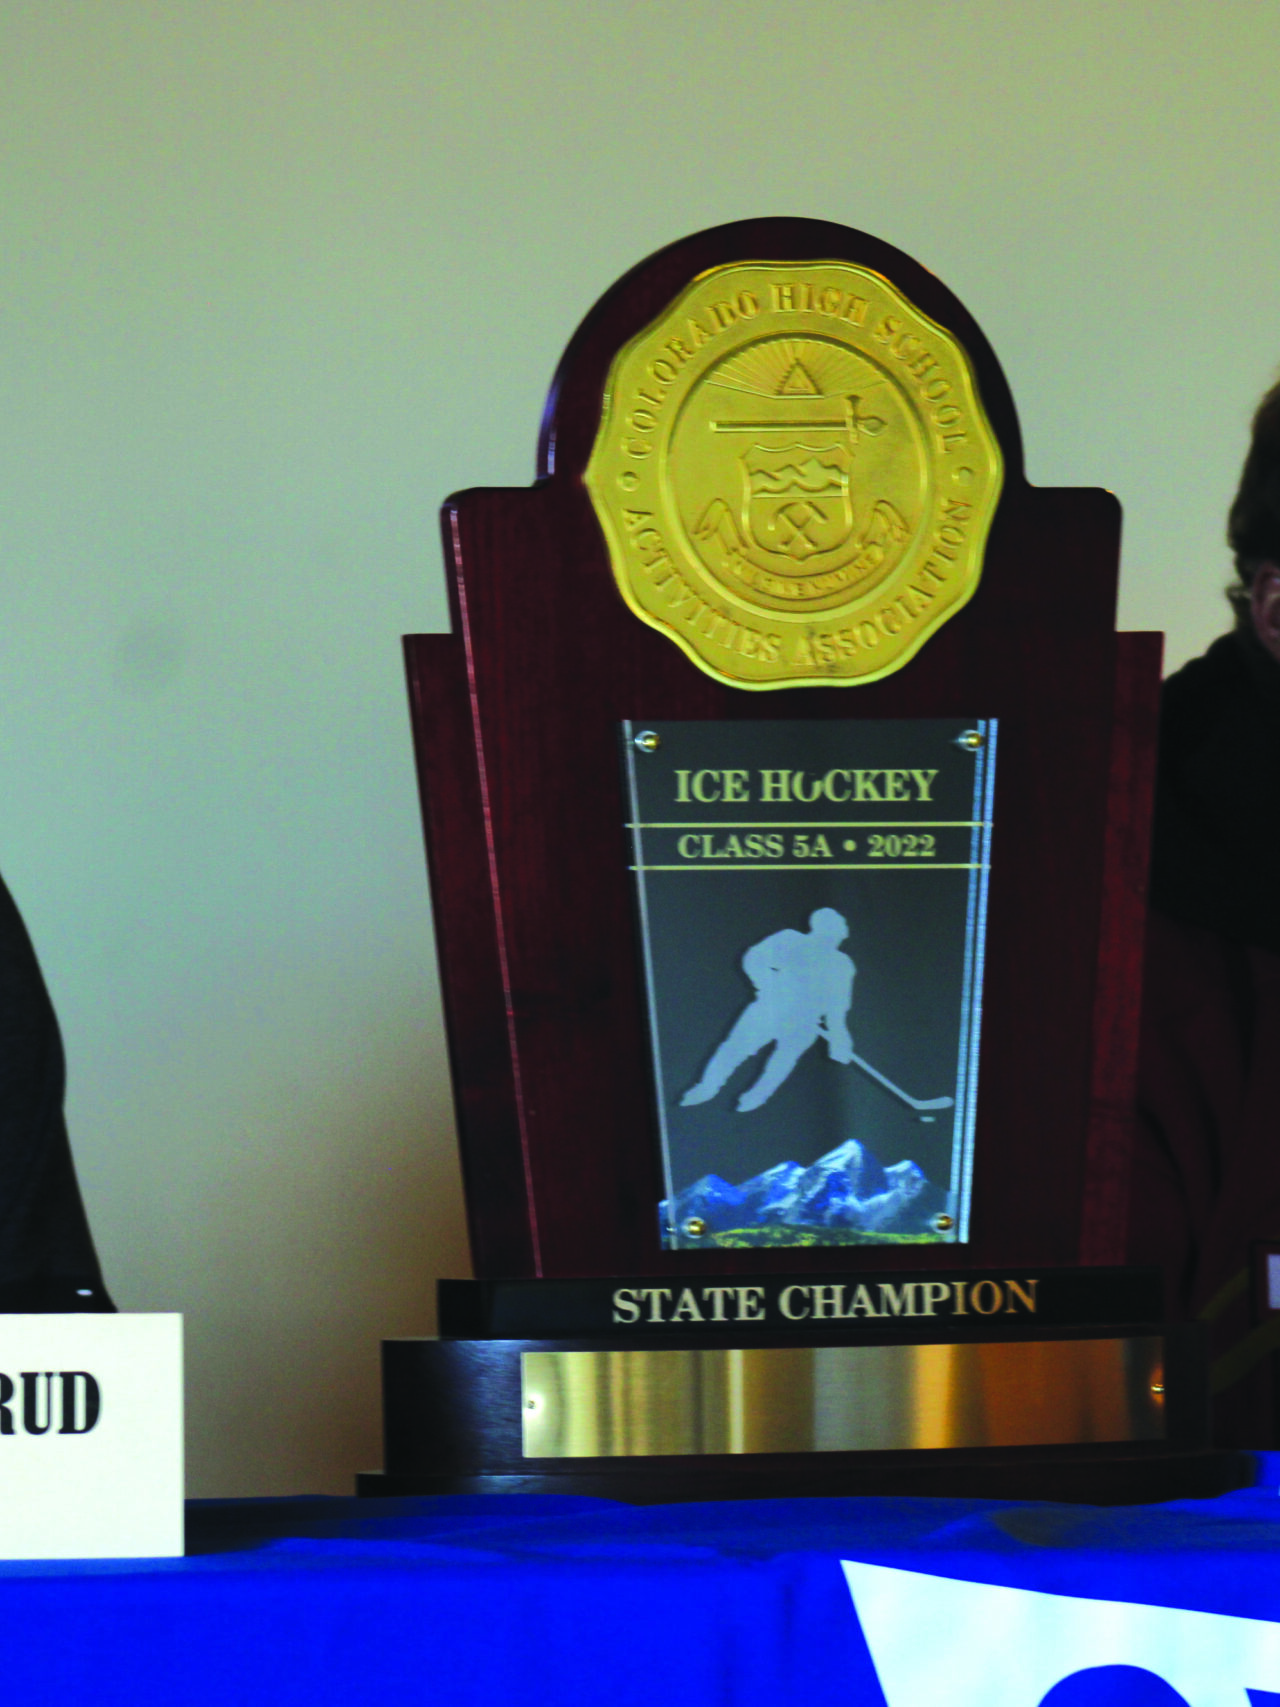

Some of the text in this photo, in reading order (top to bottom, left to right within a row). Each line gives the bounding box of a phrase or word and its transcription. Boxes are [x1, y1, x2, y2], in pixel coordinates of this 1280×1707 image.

[622, 282, 966, 459] COLORADO HIGH SCHOOL
[622, 498, 973, 666] ACTIVITIES ASSOCIATION
[674, 768, 939, 803] ICE HOCKEY
[677, 834, 937, 858] CLASS 5A 2022
[612, 1279, 1040, 1323] STATE CHAMPION
